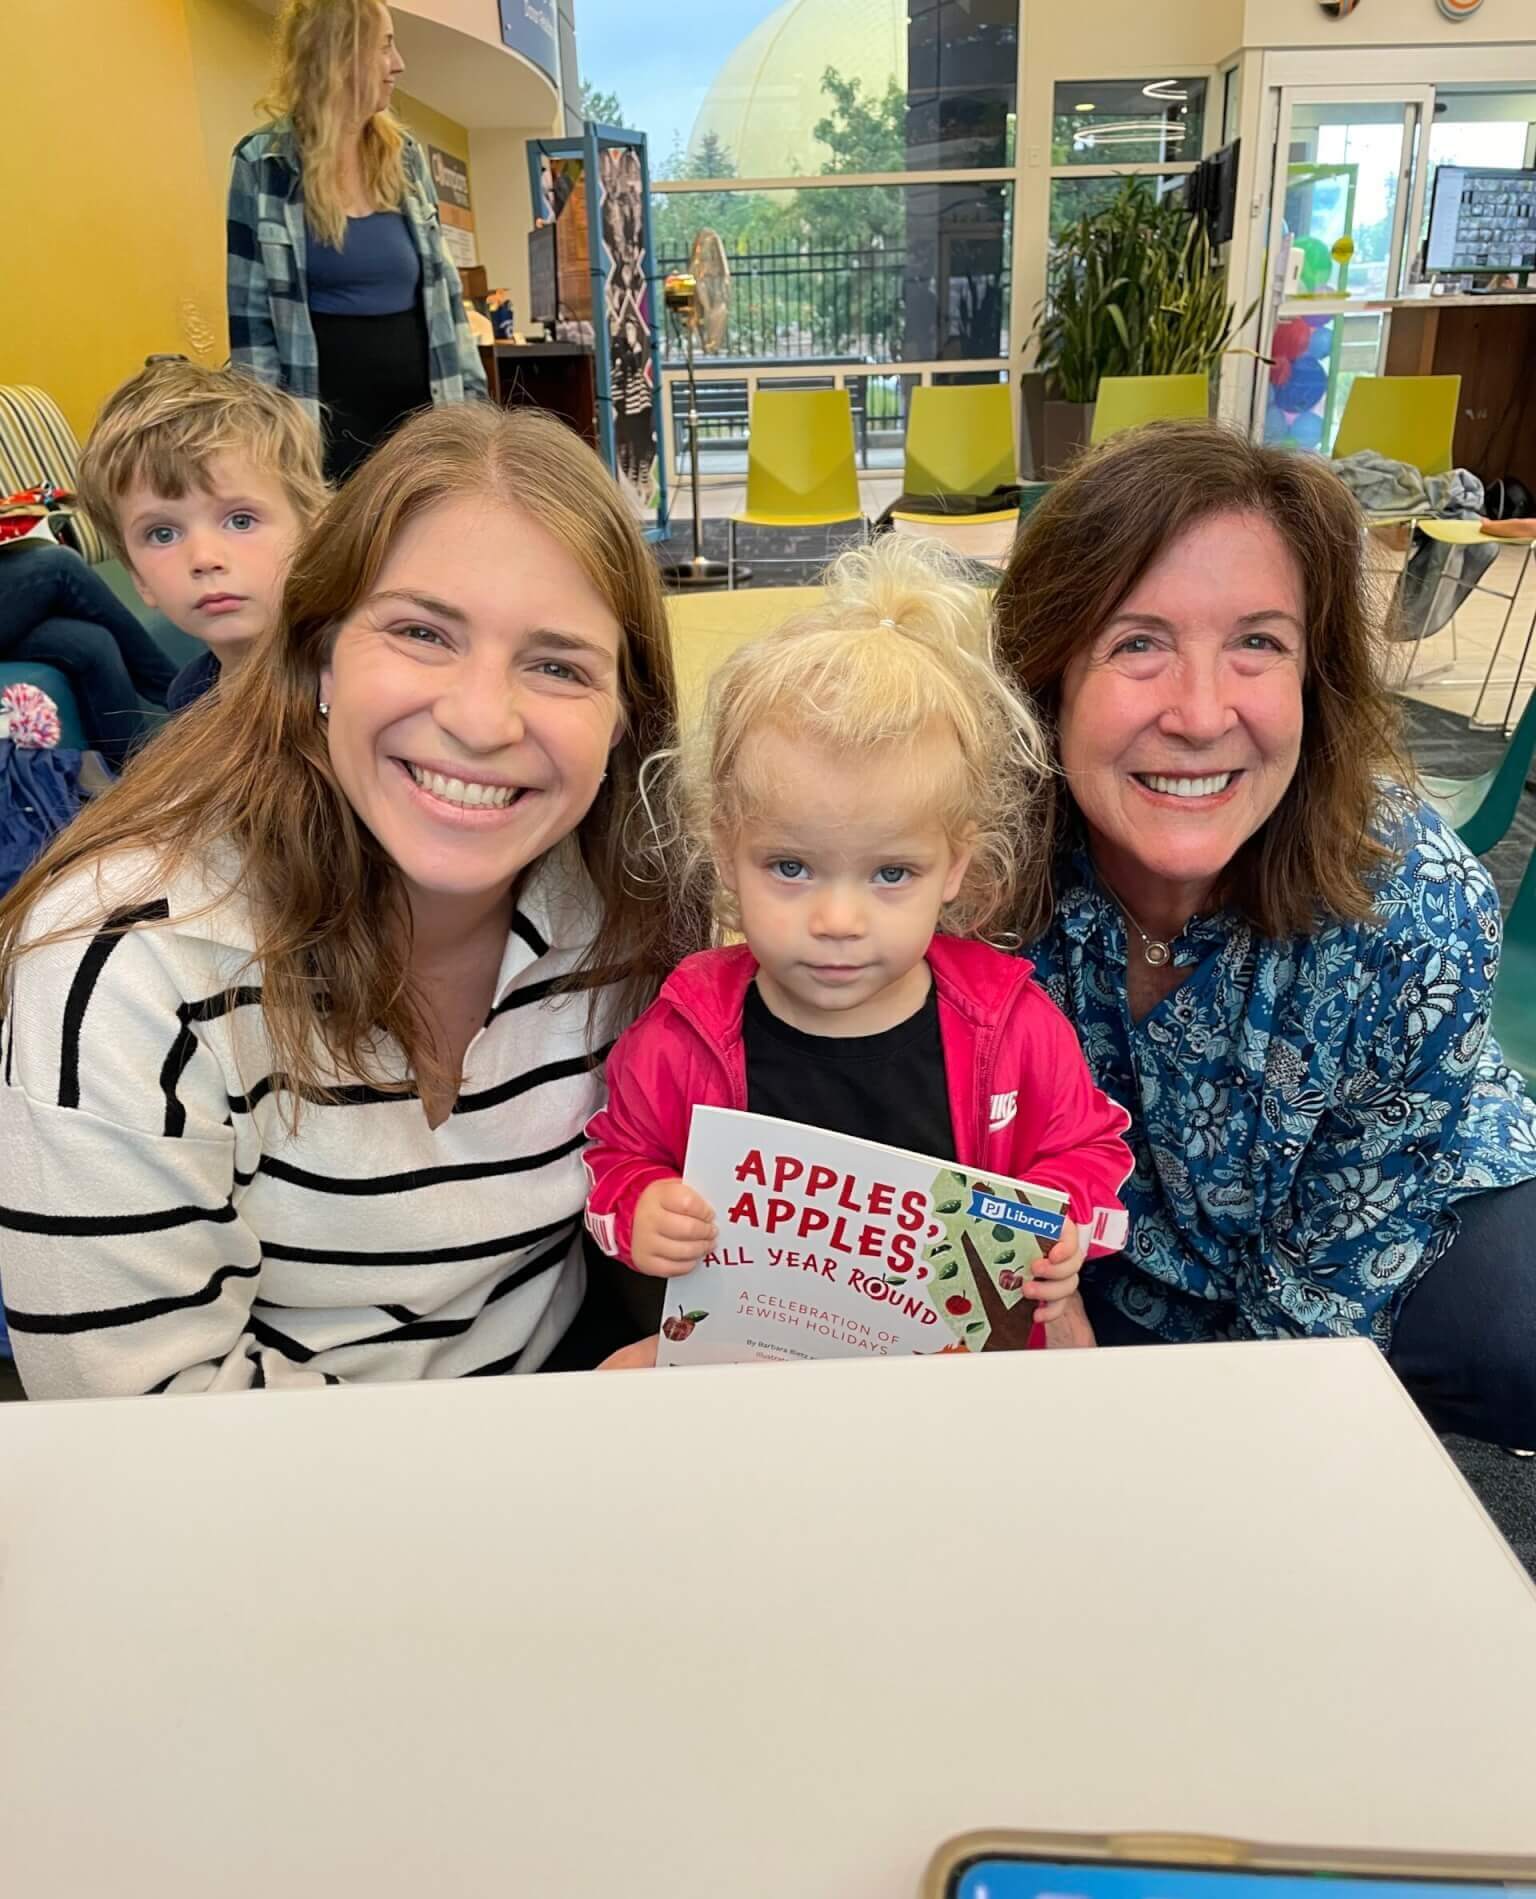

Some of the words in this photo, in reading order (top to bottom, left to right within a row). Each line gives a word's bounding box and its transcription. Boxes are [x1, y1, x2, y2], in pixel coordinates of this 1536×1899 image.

[990, 1090, 1018, 1120] IKE
[735, 1149, 939, 1238] APPLES,
[728, 1192, 928, 1280] APPLES,
[1006, 1207, 1059, 1234] Library
[703, 1246, 754, 1267] ALL
[768, 1247, 837, 1282] YEAR
[848, 1268, 938, 1326] ROUND
[737, 1305, 799, 1326] JEWISH
[806, 1320, 889, 1355] HOLIDAYS
[739, 1291, 750, 1301] A
[757, 1294, 871, 1336] CELEBRATION
[878, 1330, 901, 1345] OF
[746, 1339, 757, 1348] By
